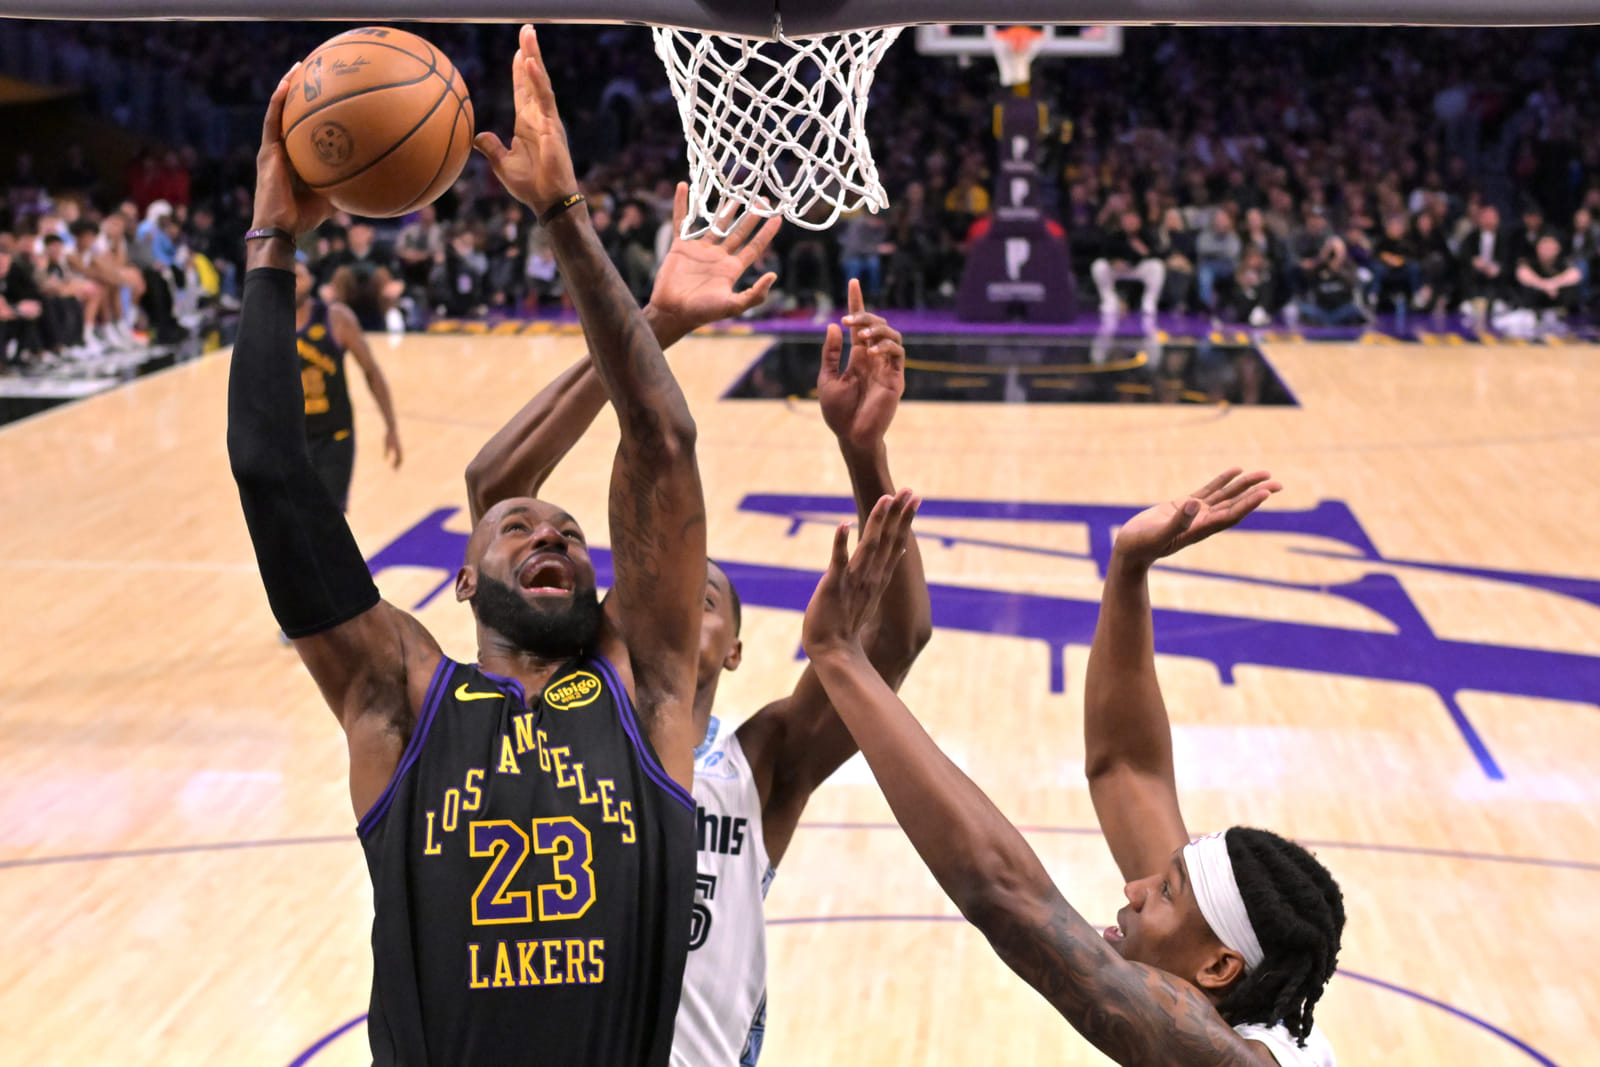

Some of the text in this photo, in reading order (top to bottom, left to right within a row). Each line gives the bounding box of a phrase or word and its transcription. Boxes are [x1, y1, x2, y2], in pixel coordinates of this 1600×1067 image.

[549, 679, 597, 702] bibigo
[423, 712, 637, 856] LOS ANGELES
[469, 816, 596, 926] 23
[468, 938, 606, 989] LAKERS
